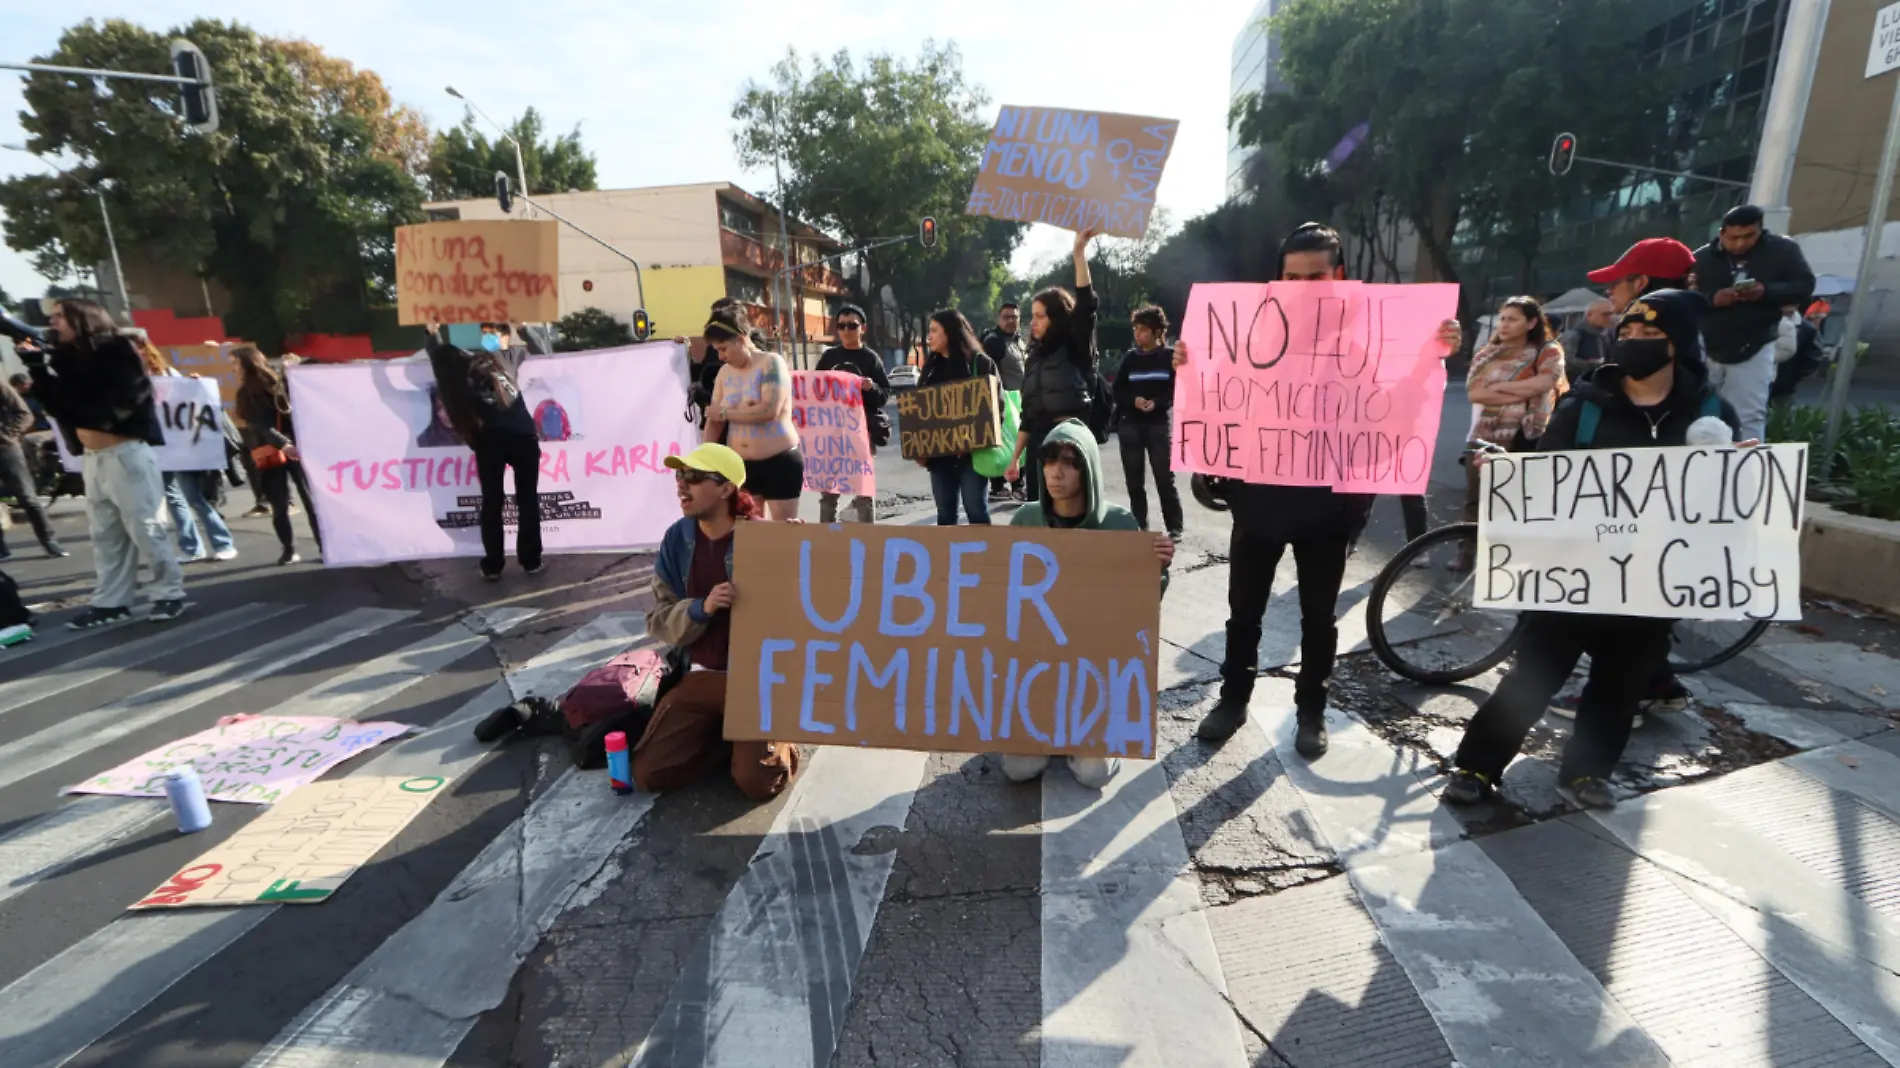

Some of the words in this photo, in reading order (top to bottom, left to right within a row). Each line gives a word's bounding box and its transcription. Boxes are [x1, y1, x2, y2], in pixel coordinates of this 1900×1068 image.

[995, 107, 1033, 139] NI
[1037, 110, 1099, 147] UNA
[980, 139, 1096, 190] MENOS
[1120, 123, 1174, 203] KARLA
[431, 234, 490, 269] una
[1207, 296, 1290, 370] NO
[1311, 295, 1406, 384] FUE
[896, 378, 995, 420] #JUSTICIA
[1200, 371, 1393, 424] HOMICIDIO
[161, 400, 218, 444] ICIA
[902, 421, 997, 457] PARAKARLA
[814, 435, 856, 456] UNA
[1178, 420, 1245, 471] FUE
[1258, 427, 1429, 485] FEMINICIDIO
[326, 455, 481, 494] JUSTICIA
[1594, 522, 1639, 544] para
[799, 537, 1069, 647] UBER
[1484, 543, 1591, 605] Brisa
[1610, 552, 1634, 604] Y
[1658, 538, 1779, 620] Gaby
[136, 862, 224, 907] NO
